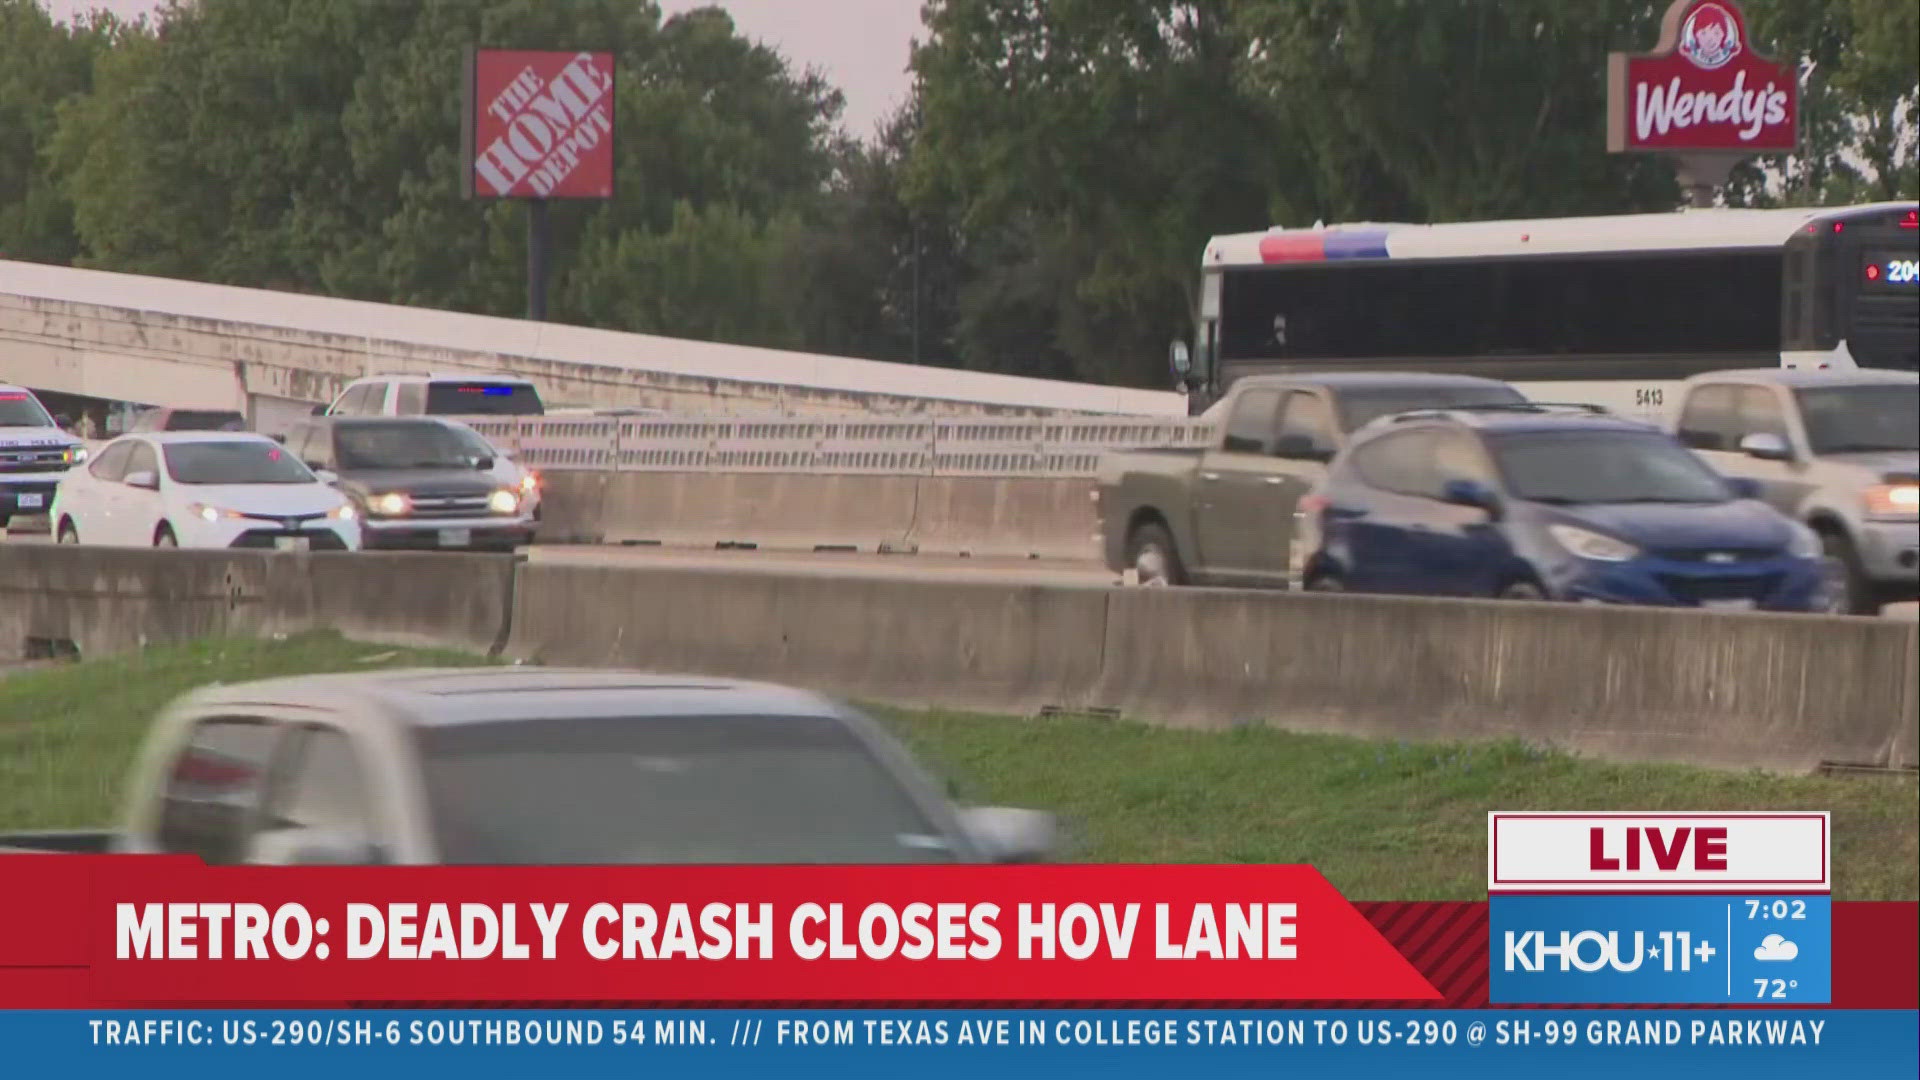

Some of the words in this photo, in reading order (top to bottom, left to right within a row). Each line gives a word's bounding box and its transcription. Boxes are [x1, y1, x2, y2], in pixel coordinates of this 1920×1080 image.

[475, 52, 612, 195] HOME
[488, 65, 544, 124] THE
[1636, 69, 1788, 141] Wendy's
[528, 104, 611, 198] DEPOT
[1636, 389, 1663, 406] 5413
